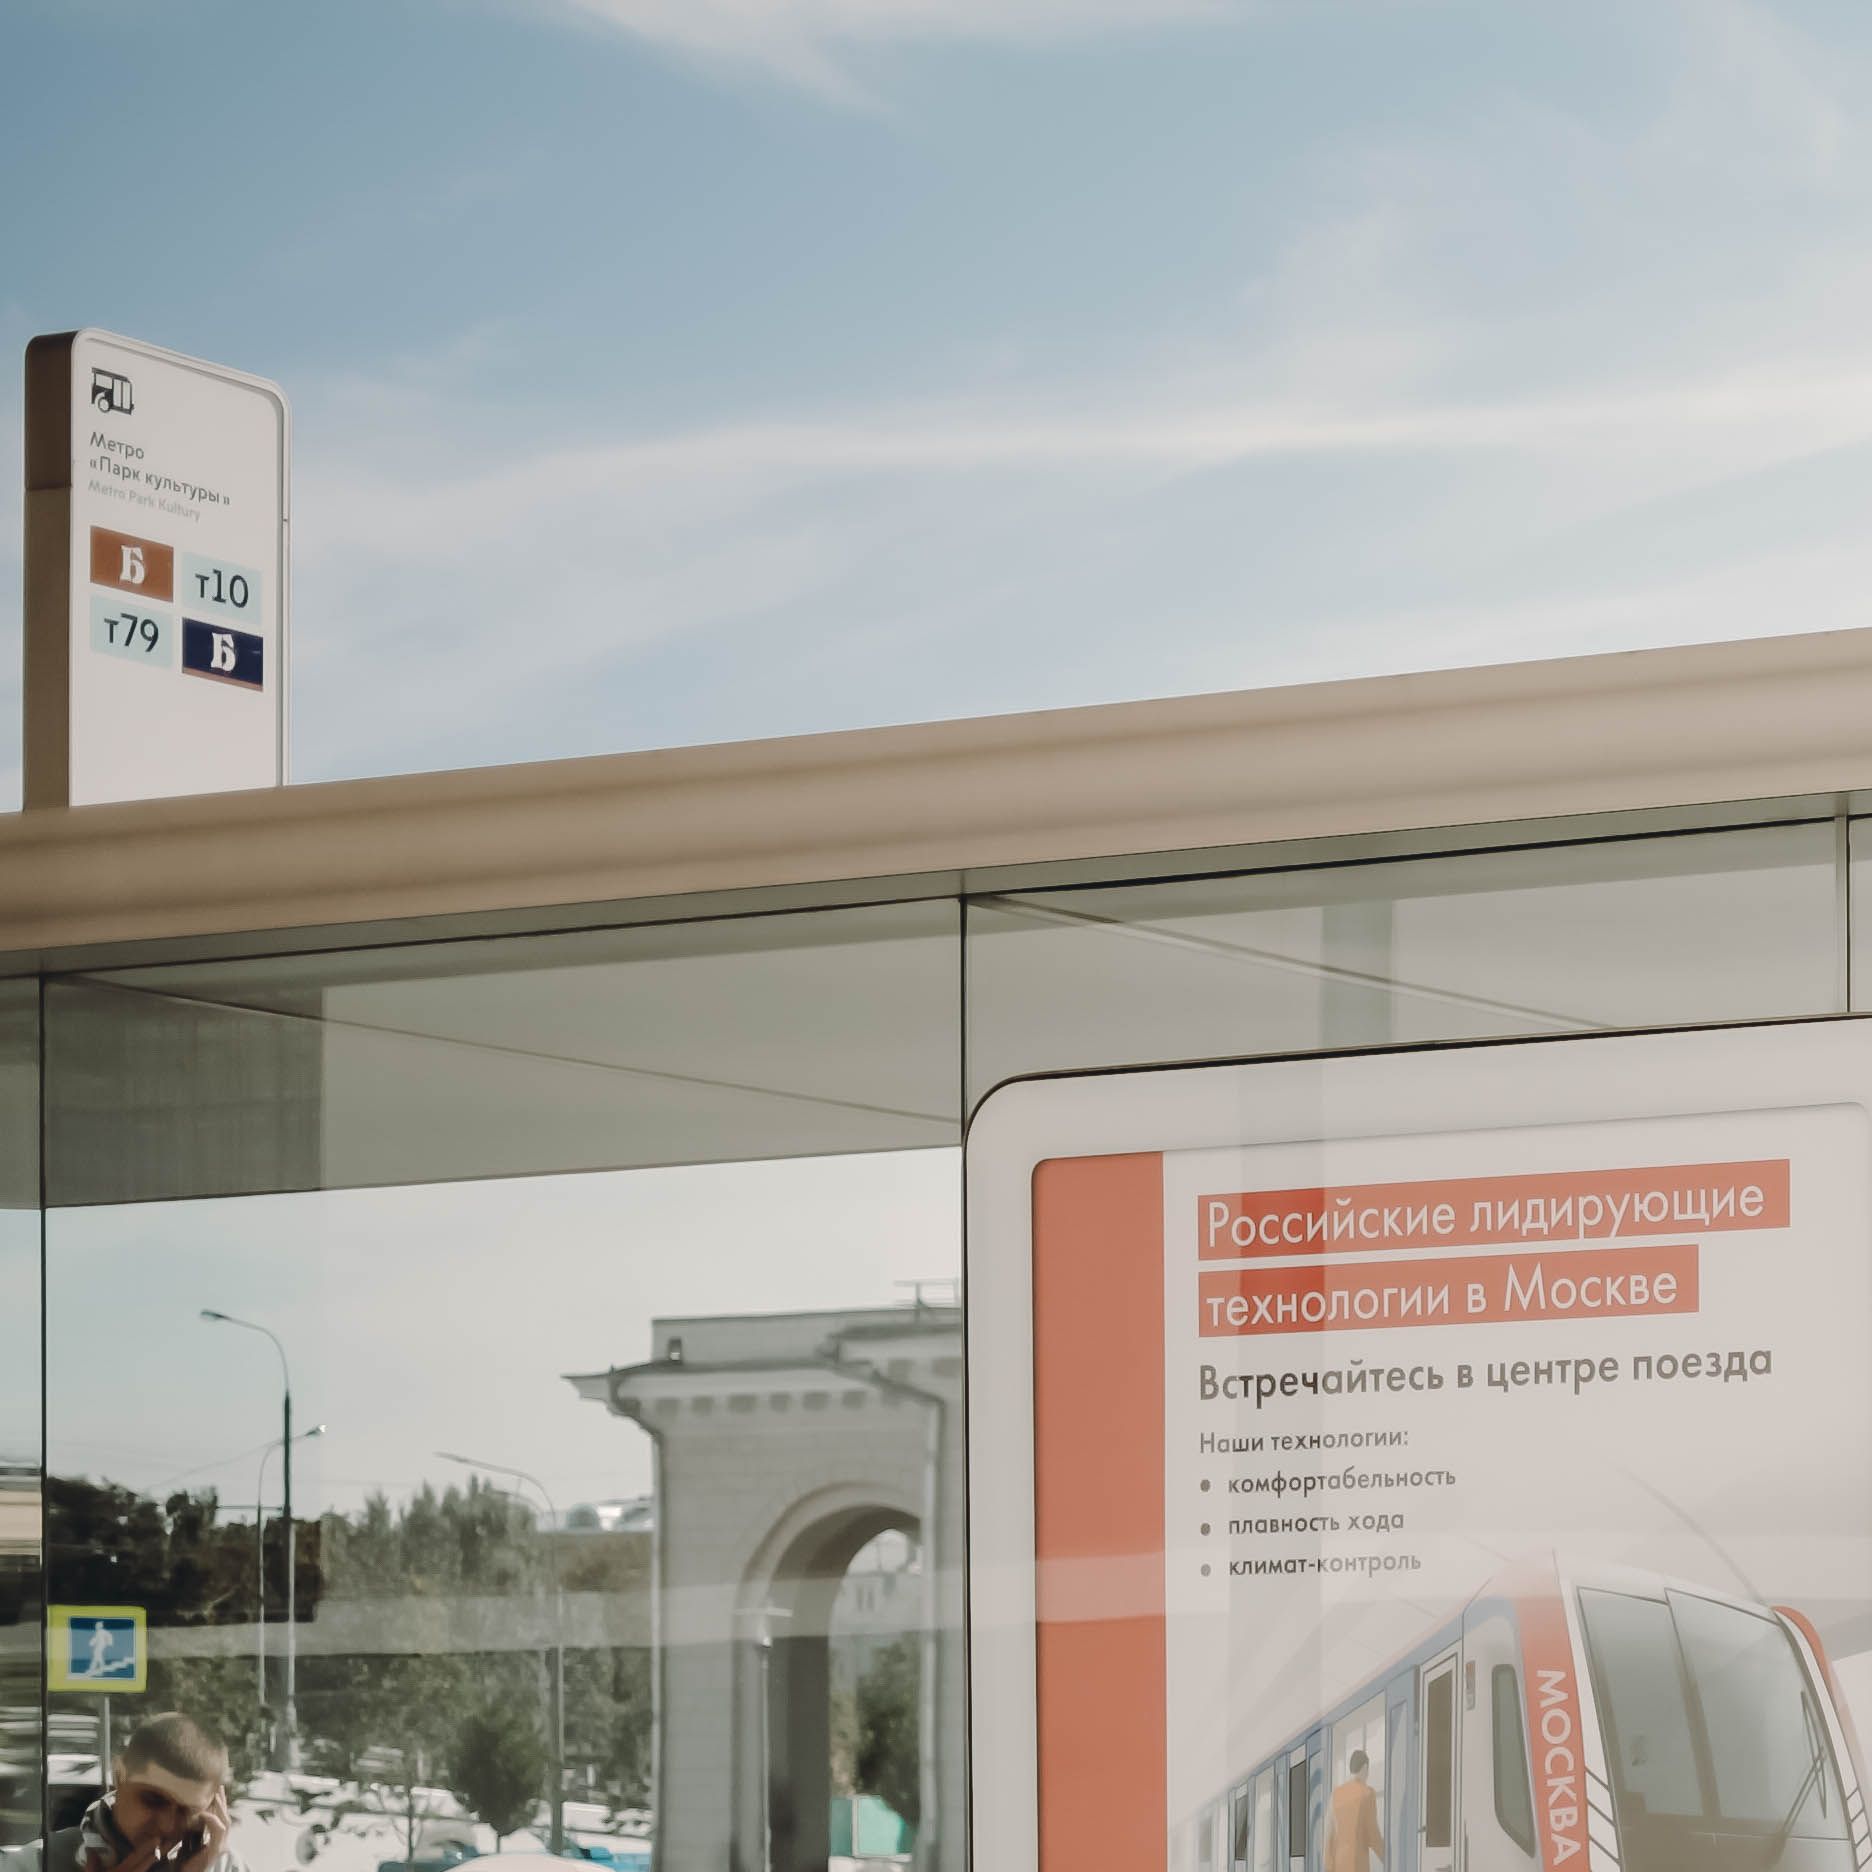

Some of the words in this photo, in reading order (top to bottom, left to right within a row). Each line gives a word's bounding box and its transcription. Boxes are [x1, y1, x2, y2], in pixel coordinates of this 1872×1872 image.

[89, 431, 145, 460] Метро
[88, 479, 127, 499] Metro
[129, 488, 154, 508] Park
[158, 500, 201, 523] Kultury
[89, 455, 141, 481] «Парк
[145, 471, 231, 506] культуры»
[118, 544, 147, 585] Б
[210, 631, 238, 673] Б
[1206, 1197, 1457, 1250] Российские
[1469, 1181, 1767, 1240] лидирующие
[1206, 1281, 1451, 1329] технологии
[1465, 1282, 1488, 1315] в
[1502, 1262, 1679, 1315] Москве
[1199, 1359, 1445, 1410] Встречайтесь
[1456, 1364, 1475, 1390] в
[1485, 1352, 1620, 1396] центре
[1631, 1346, 1774, 1385] поезда
[1200, 1431, 1265, 1454] Наши
[1270, 1429, 1410, 1451] технологии:
[1227, 1464, 1457, 1500] комфортабельность
[1227, 1514, 1341, 1536] плавность
[1347, 1512, 1405, 1534] хода
[1228, 1552, 1423, 1579] климат-контроль
[1535, 1667, 1582, 1866] МОСКВА
